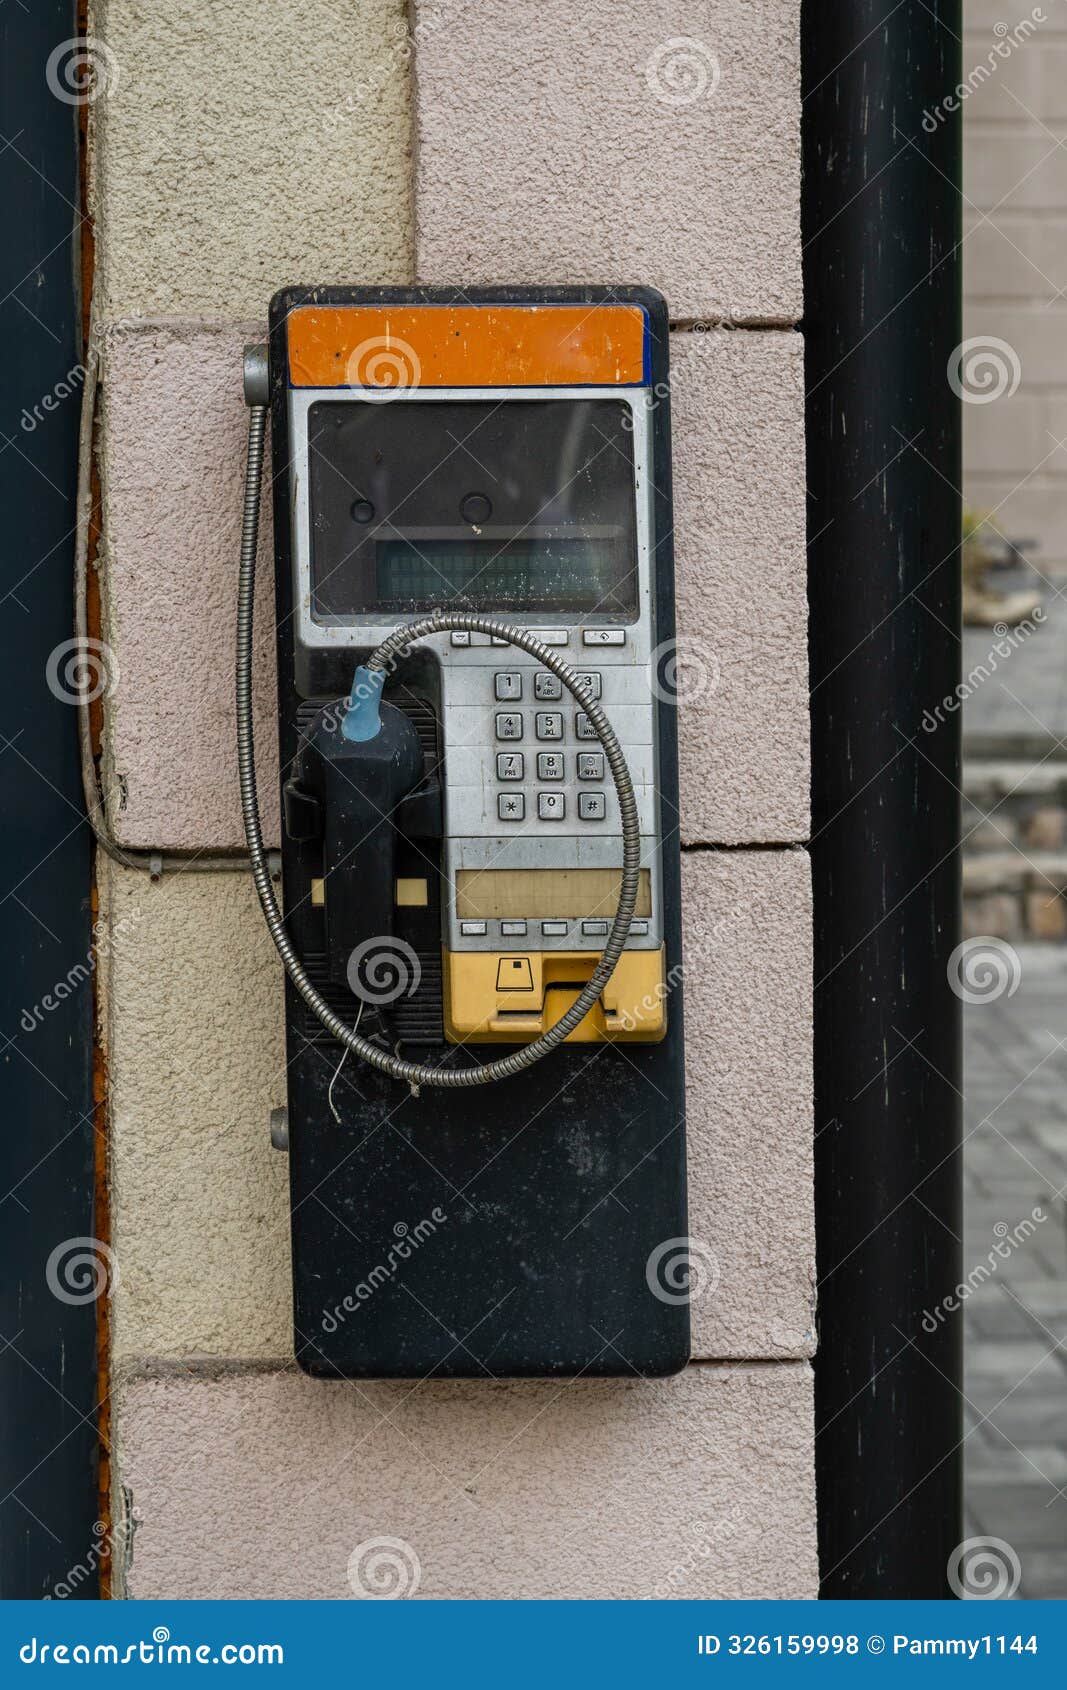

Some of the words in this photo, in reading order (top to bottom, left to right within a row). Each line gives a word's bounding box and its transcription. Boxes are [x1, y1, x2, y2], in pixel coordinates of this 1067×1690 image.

[506, 676, 512, 687] 1
[584, 676, 592, 686] 3
[504, 716, 513, 727] 4
[545, 716, 553, 726] 5
[506, 757, 514, 767] 7
[547, 757, 555, 766] 8
[547, 796, 555, 806] 0
